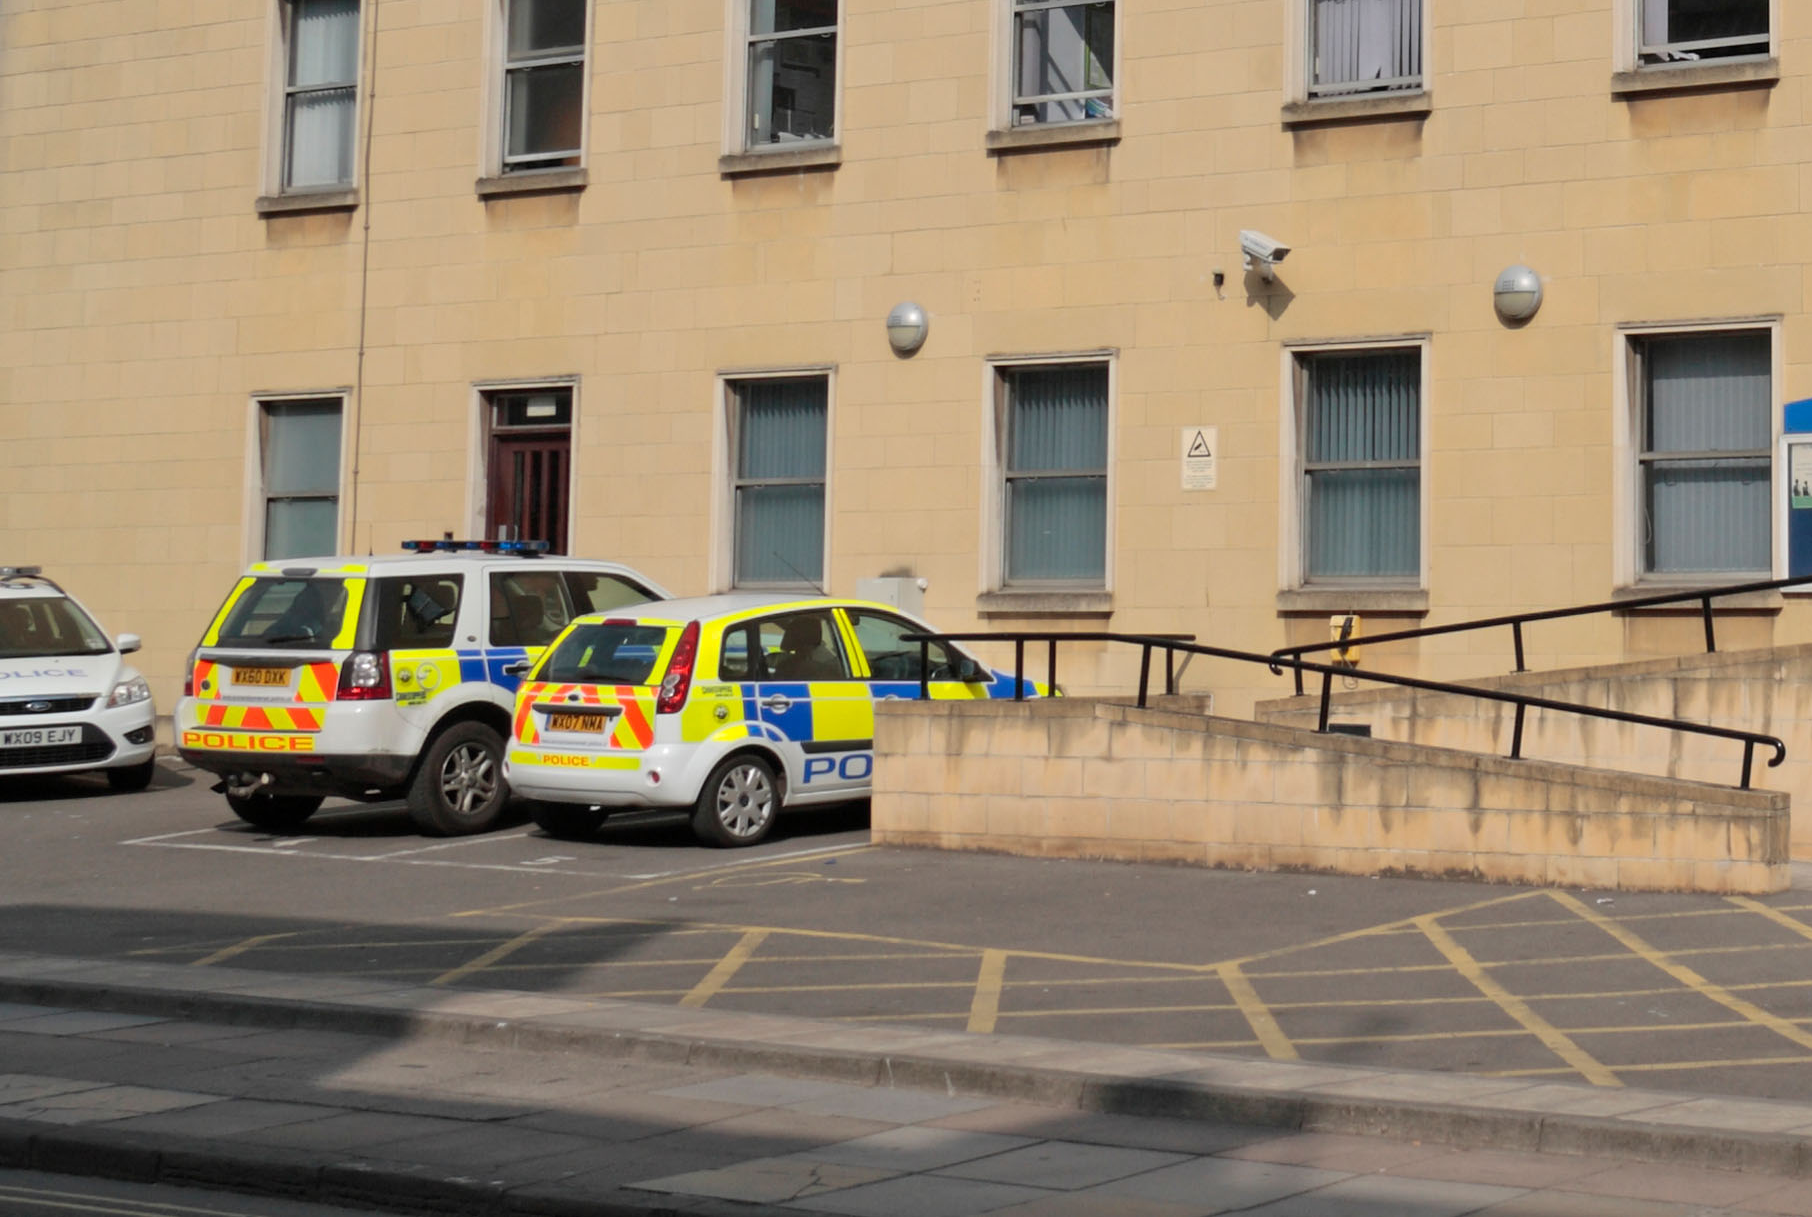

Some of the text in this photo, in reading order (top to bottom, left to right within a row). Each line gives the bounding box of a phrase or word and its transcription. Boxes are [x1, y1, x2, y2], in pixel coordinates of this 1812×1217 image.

[4, 729, 75, 745] WX09 EJY
[183, 732, 312, 751] POLICE
[543, 755, 589, 767] POLICE
